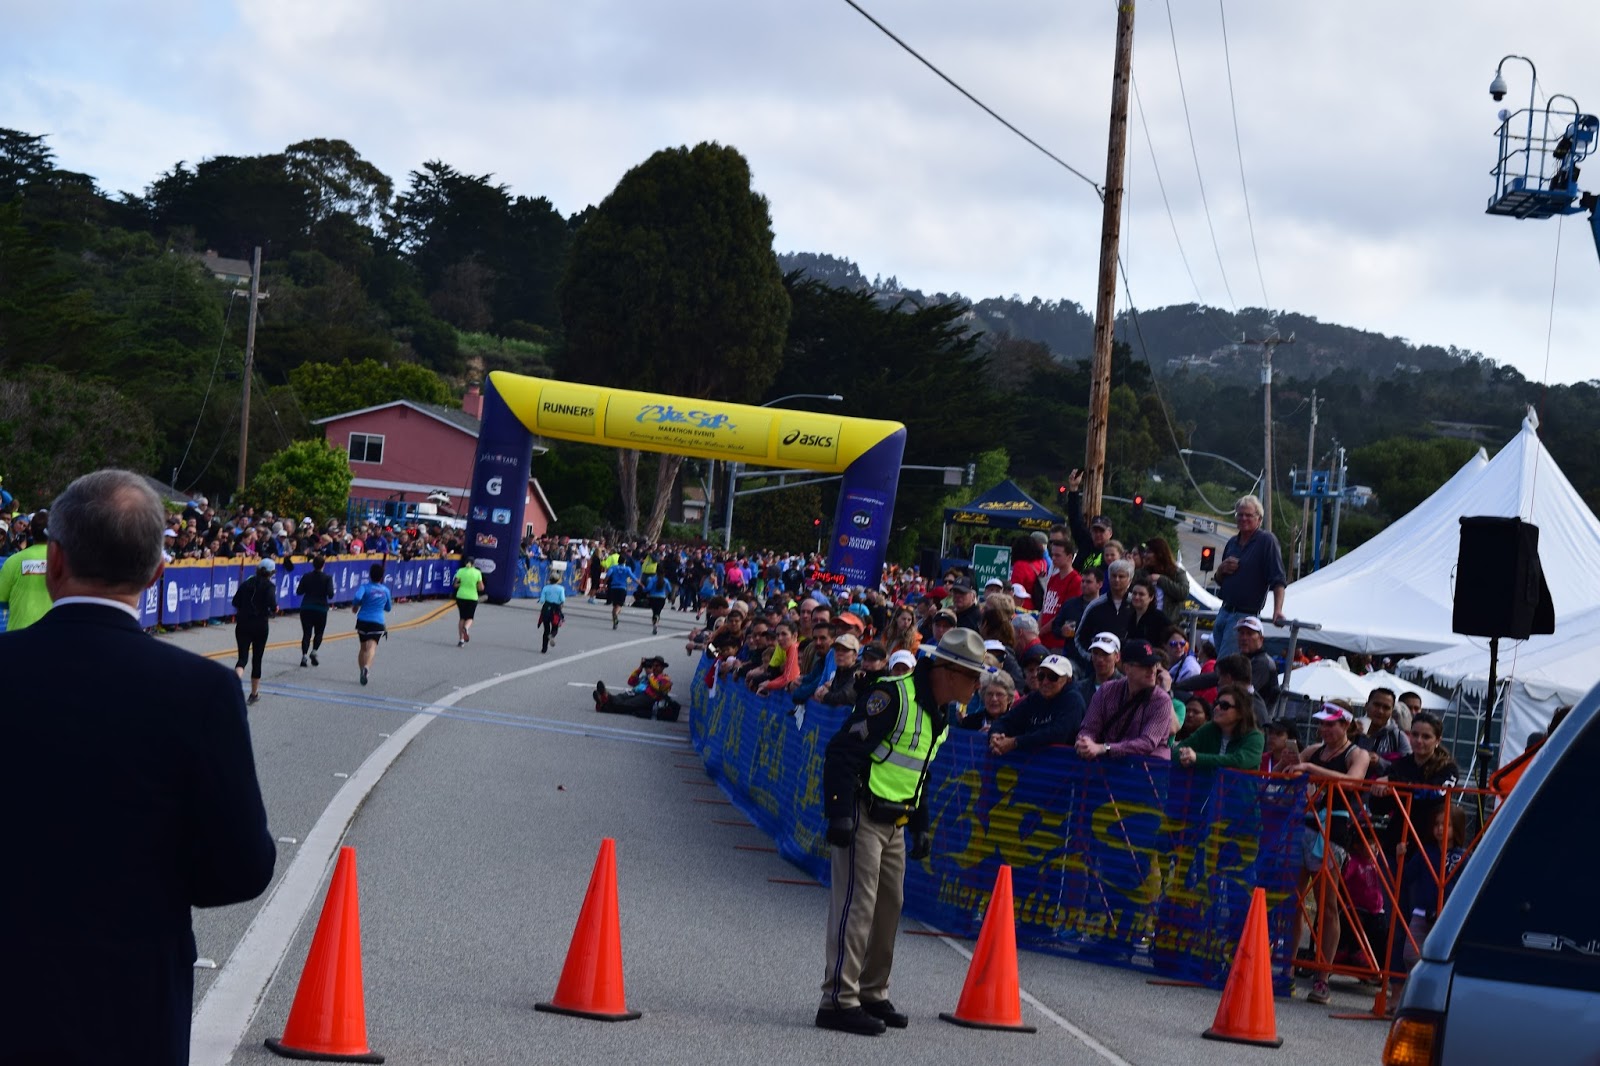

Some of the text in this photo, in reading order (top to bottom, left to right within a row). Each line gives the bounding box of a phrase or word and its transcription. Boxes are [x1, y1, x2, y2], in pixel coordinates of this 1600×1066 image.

[543, 401, 595, 417] RUNNERS
[658, 425, 715, 438] MARATHON EVENTS
[486, 476, 503, 496] G
[853, 514, 870, 526] GU
[974, 564, 1007, 576] PARK &
[1049, 656, 1059, 664] N
